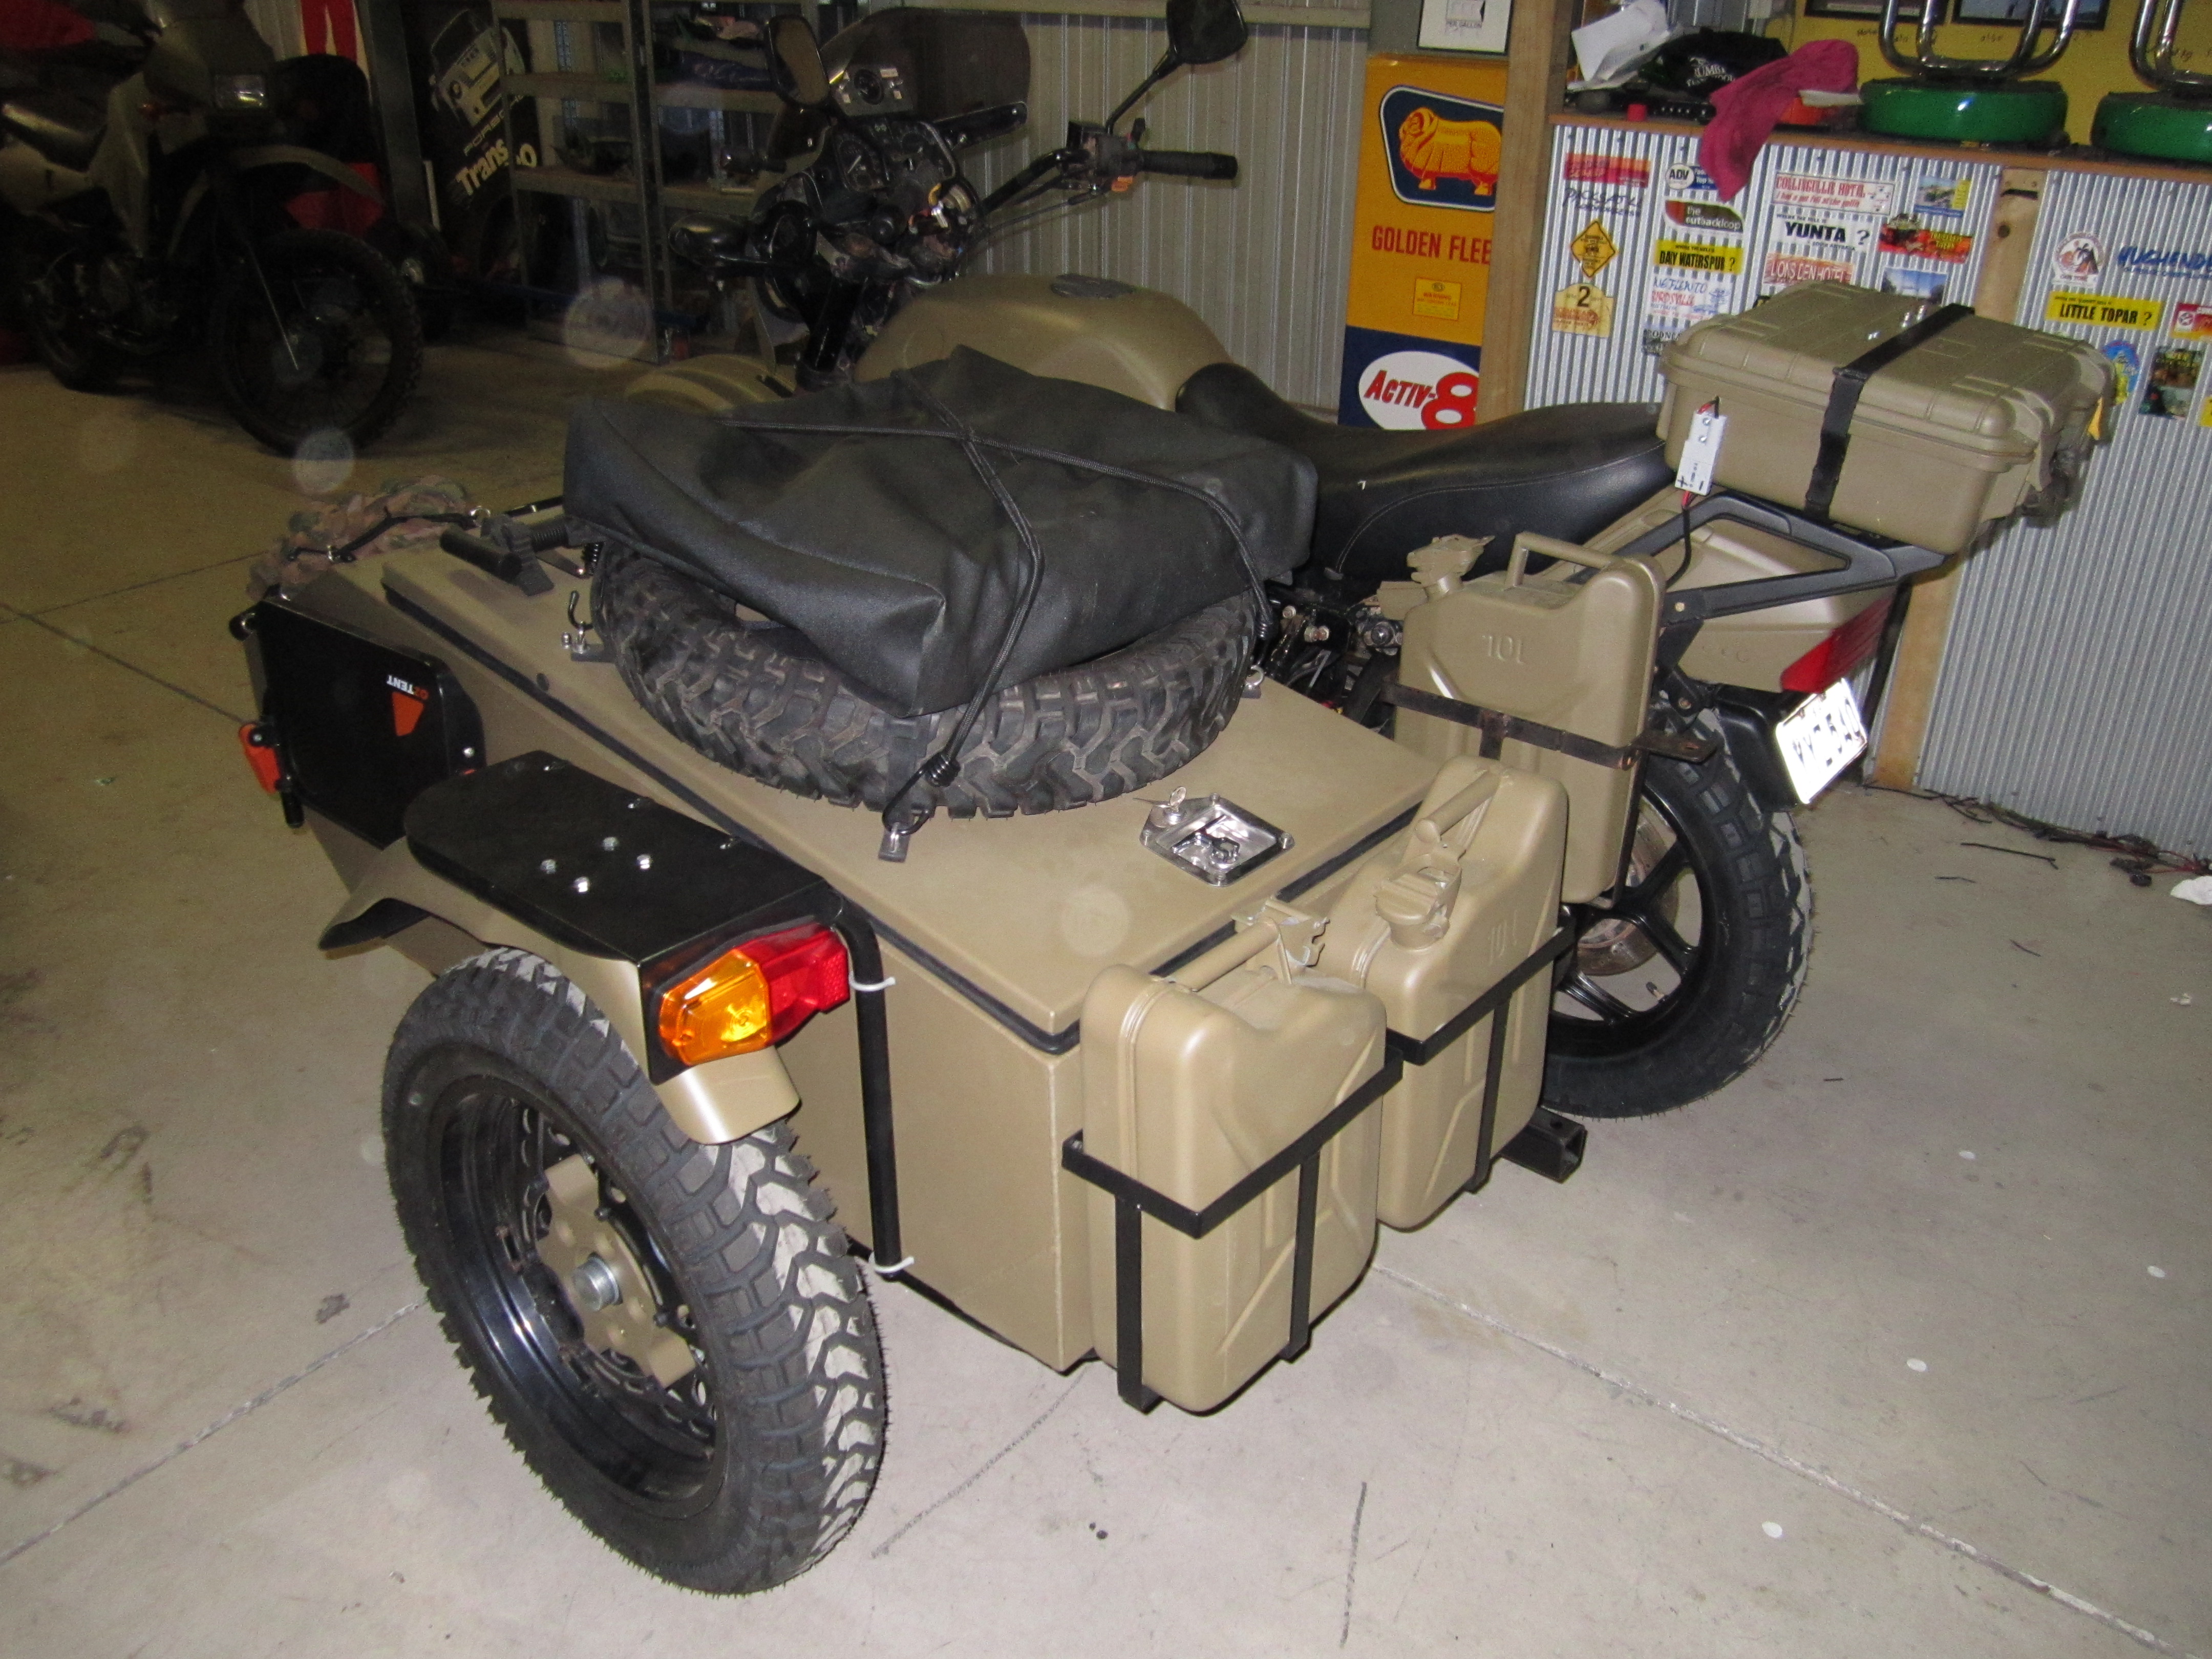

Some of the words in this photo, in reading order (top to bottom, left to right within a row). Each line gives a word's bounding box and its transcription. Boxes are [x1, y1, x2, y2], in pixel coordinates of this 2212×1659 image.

[463, 95, 524, 156] PORSC
[1669, 169, 1689, 180] ADV
[1687, 206, 1701, 215] the
[1785, 221, 1846, 243] YUNTA
[1857, 230, 1870, 245] ?
[1371, 225, 1442, 260] GOLDEN
[1449, 235, 1492, 265] FLEE
[1729, 257, 1735, 271] ?
[1577, 286, 1591, 307] 2
[2059, 303, 2097, 320] LITTLE
[2100, 307, 2139, 325] TOPAR
[2143, 311, 2154, 326] ?
